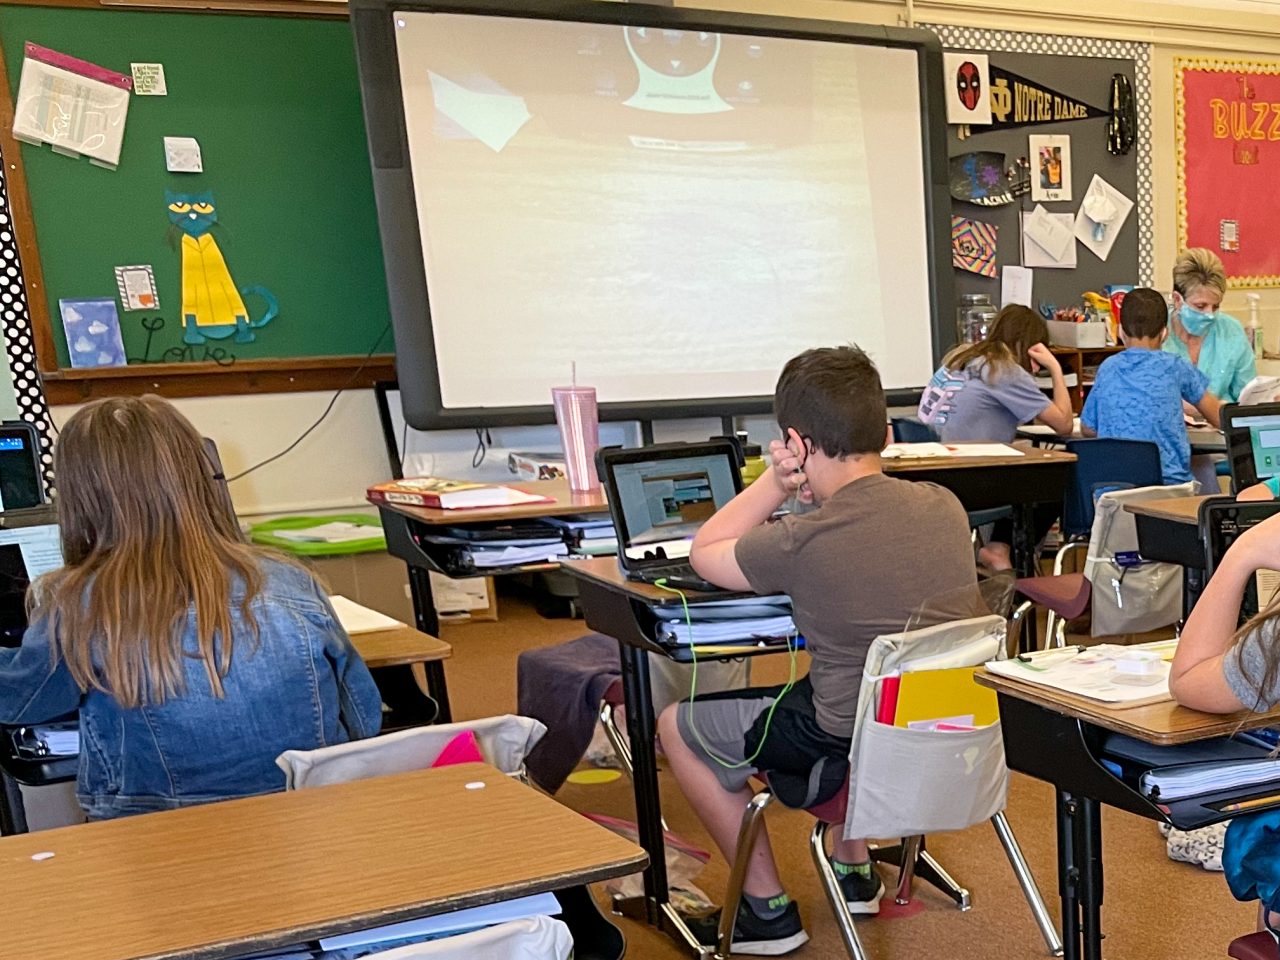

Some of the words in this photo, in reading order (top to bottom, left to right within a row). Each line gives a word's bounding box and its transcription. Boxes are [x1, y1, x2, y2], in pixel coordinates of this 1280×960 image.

[1014, 82, 1052, 122] NOTRE
[1054, 97, 1088, 120] DAME
[127, 317, 236, 367] Love
